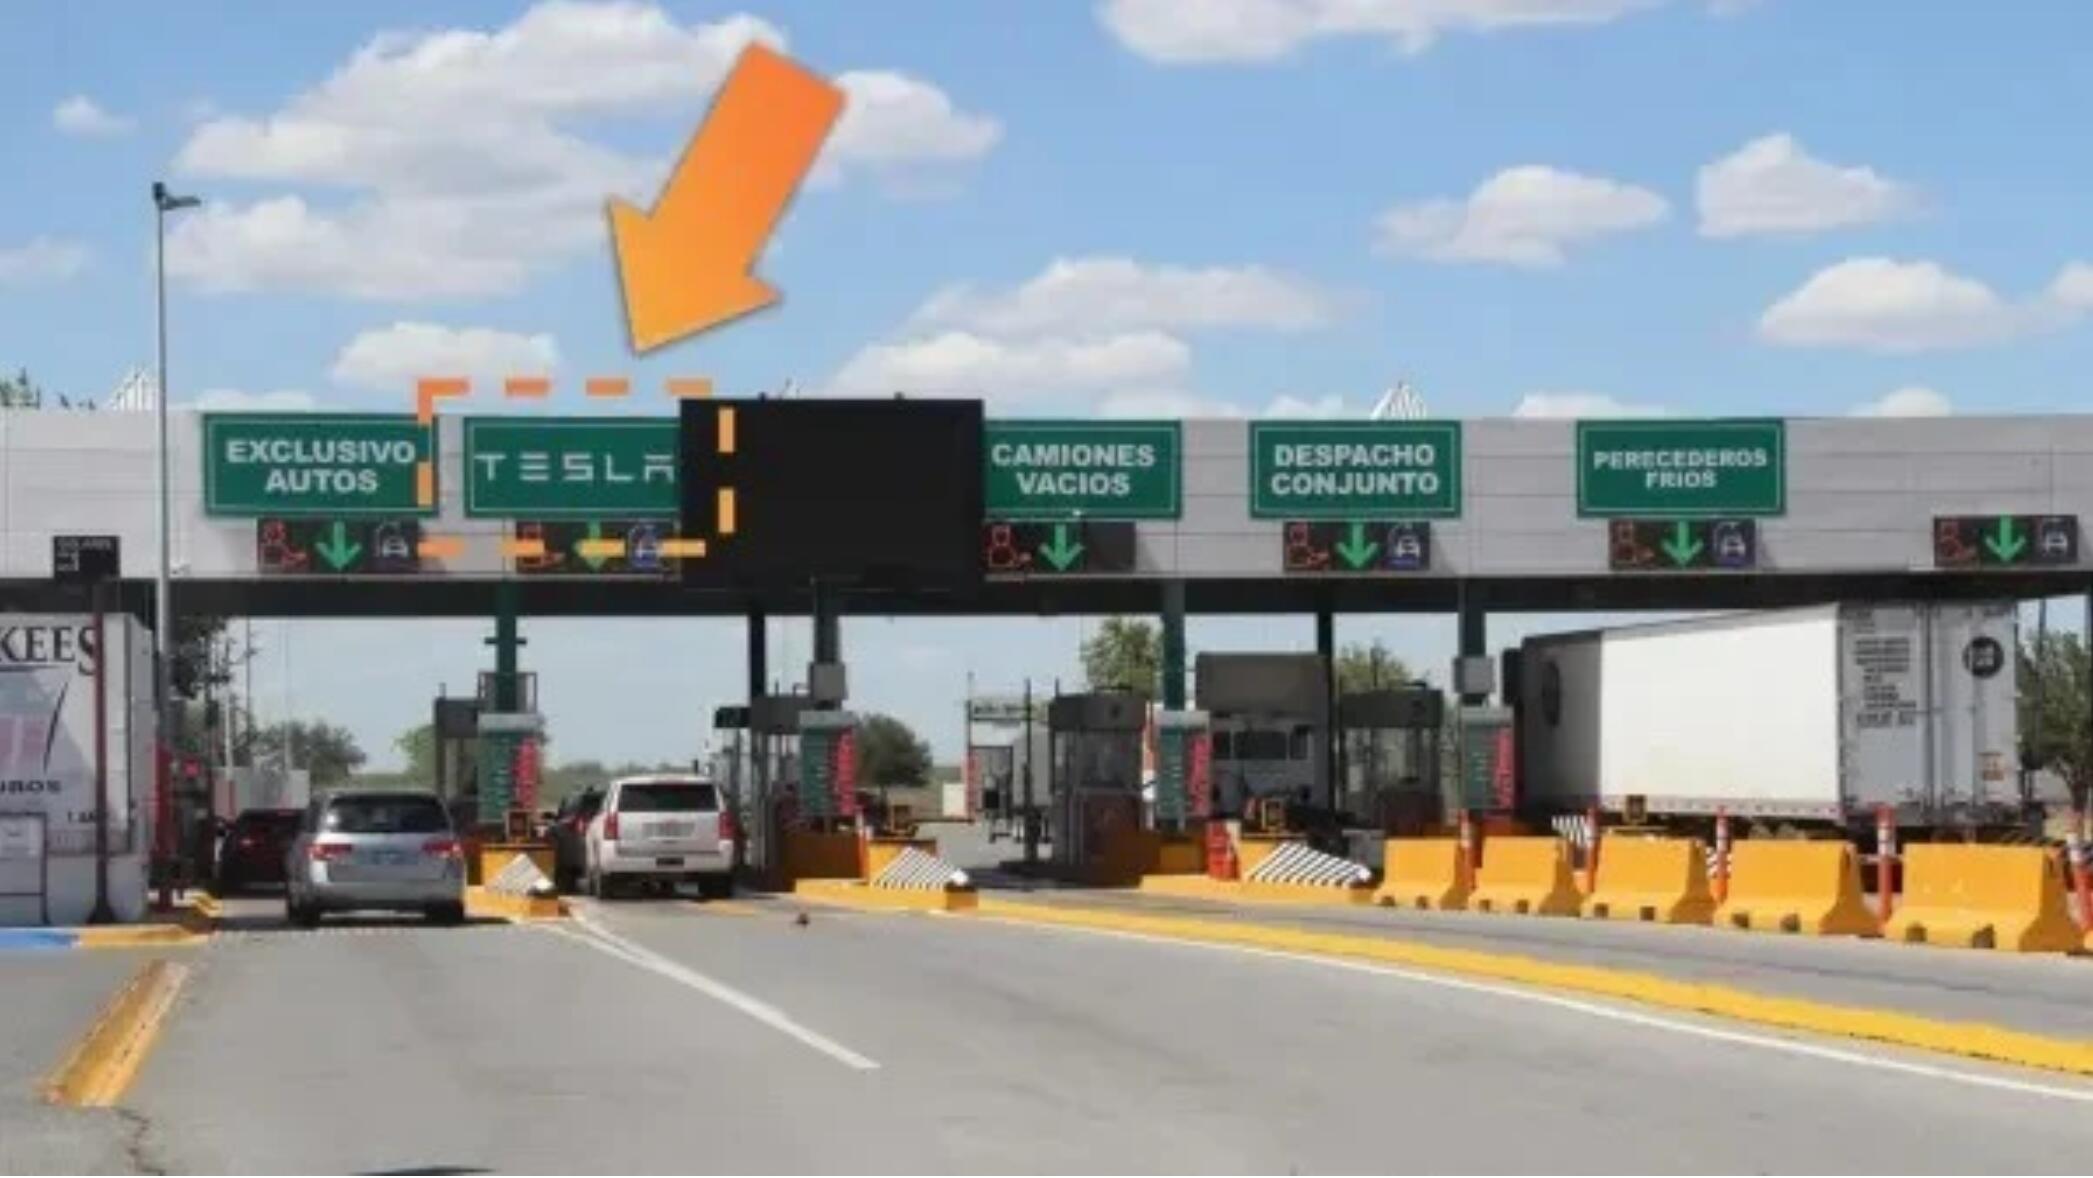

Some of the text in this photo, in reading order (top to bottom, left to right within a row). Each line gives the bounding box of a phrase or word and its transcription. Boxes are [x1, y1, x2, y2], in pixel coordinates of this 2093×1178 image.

[226, 440, 416, 463] EXCLUSIVO
[991, 444, 1155, 467] CAMIONES
[1274, 444, 1436, 467] DESPACHO
[1593, 450, 1768, 469] PERECEDEROS
[474, 453, 675, 482] TESLA
[265, 469, 379, 493] AUTOS
[1016, 472, 1131, 495] VACIOS
[1270, 472, 1439, 495] CONJUNTO
[1645, 471, 1717, 488] FRIOS
